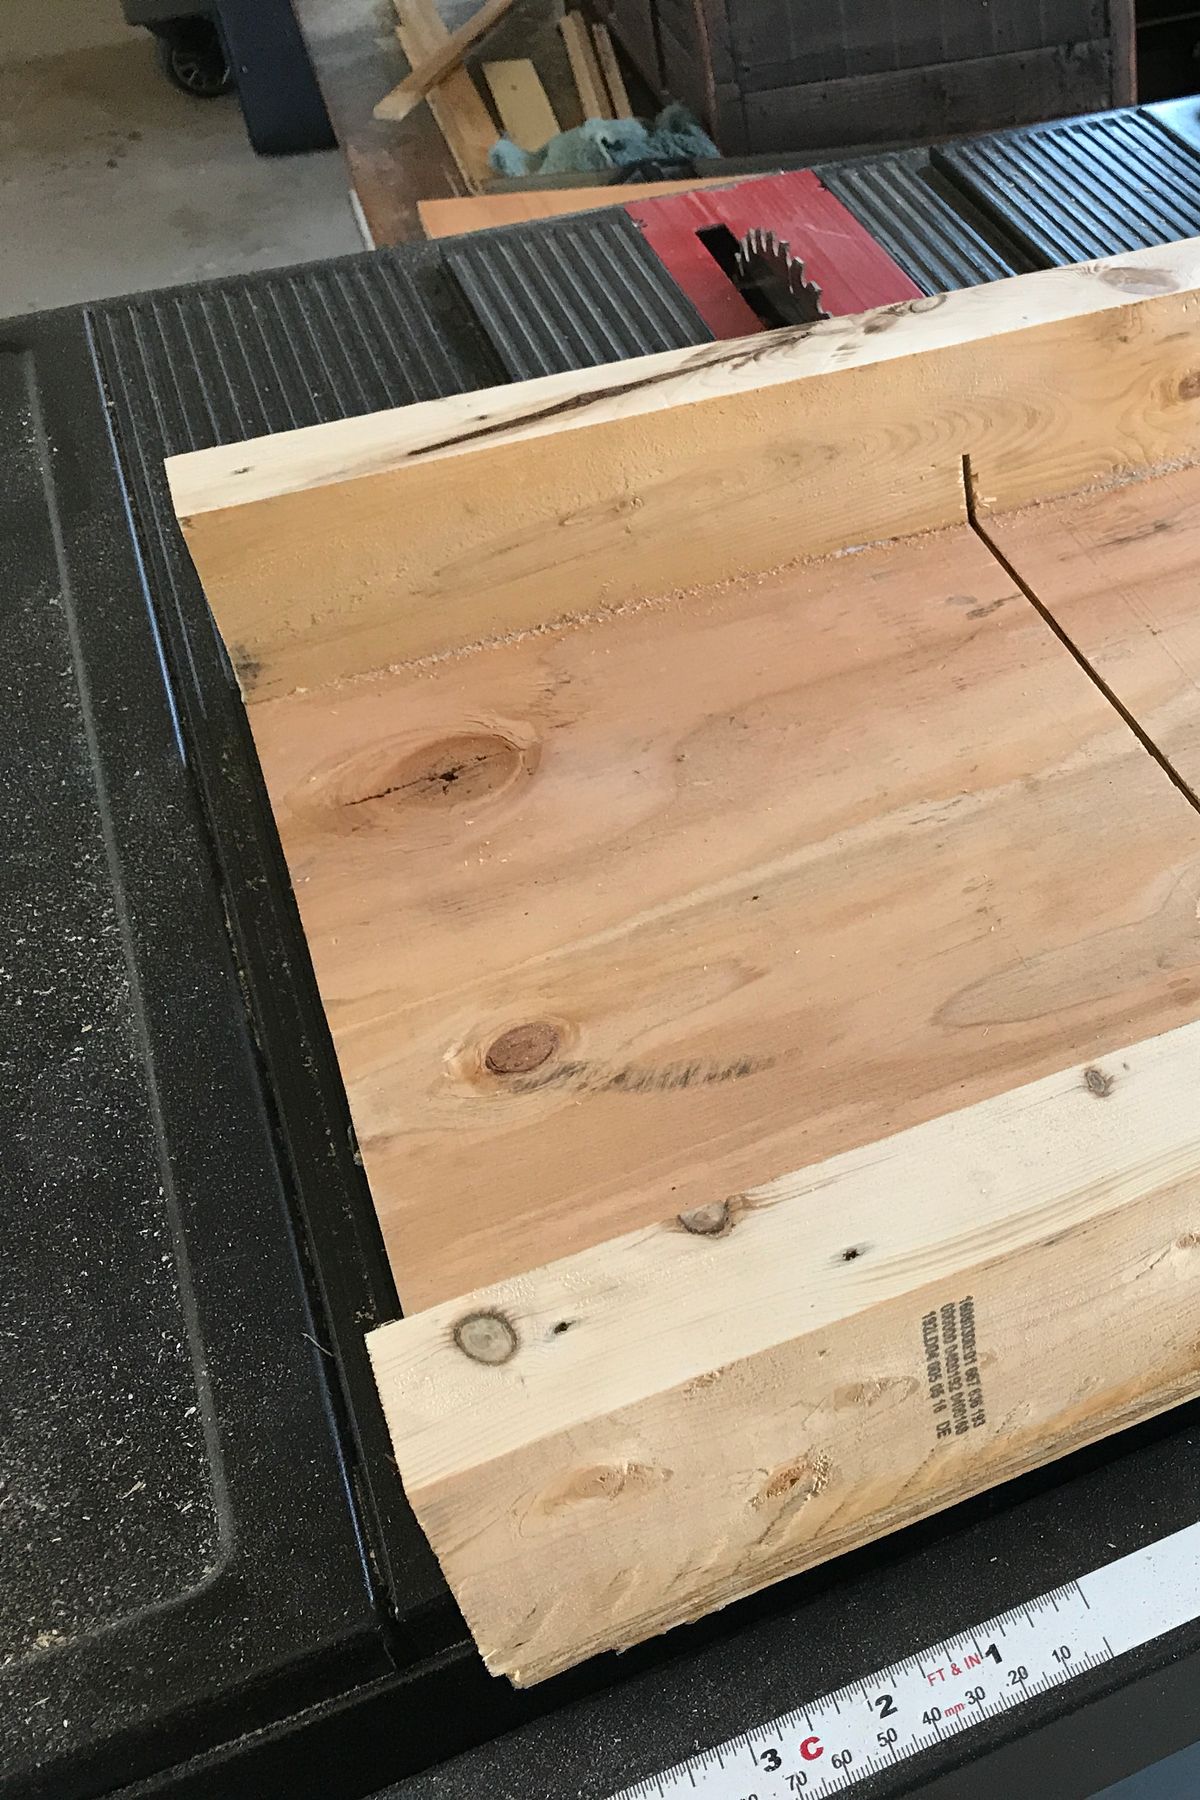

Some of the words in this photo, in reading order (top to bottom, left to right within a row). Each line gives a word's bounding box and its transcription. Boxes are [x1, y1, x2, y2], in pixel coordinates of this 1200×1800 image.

[936, 1420, 951, 1439] DE
[760, 1748, 782, 1772] 3
[800, 1736, 824, 1760] C
[875, 1694, 898, 1719] 2
[927, 1668, 946, 1686] FT
[950, 1663, 963, 1676] &
[964, 1653, 982, 1669] IN
[985, 1643, 1002, 1664] 1
[785, 1770, 808, 1791] 70
[831, 1749, 852, 1769] 60
[877, 1727, 898, 1747] 50
[922, 1707, 941, 1725] 40
[944, 1703, 964, 1717] mm
[964, 1686, 986, 1705] 30
[1007, 1665, 1028, 1685] 20
[1051, 1645, 1072, 1662] 10
